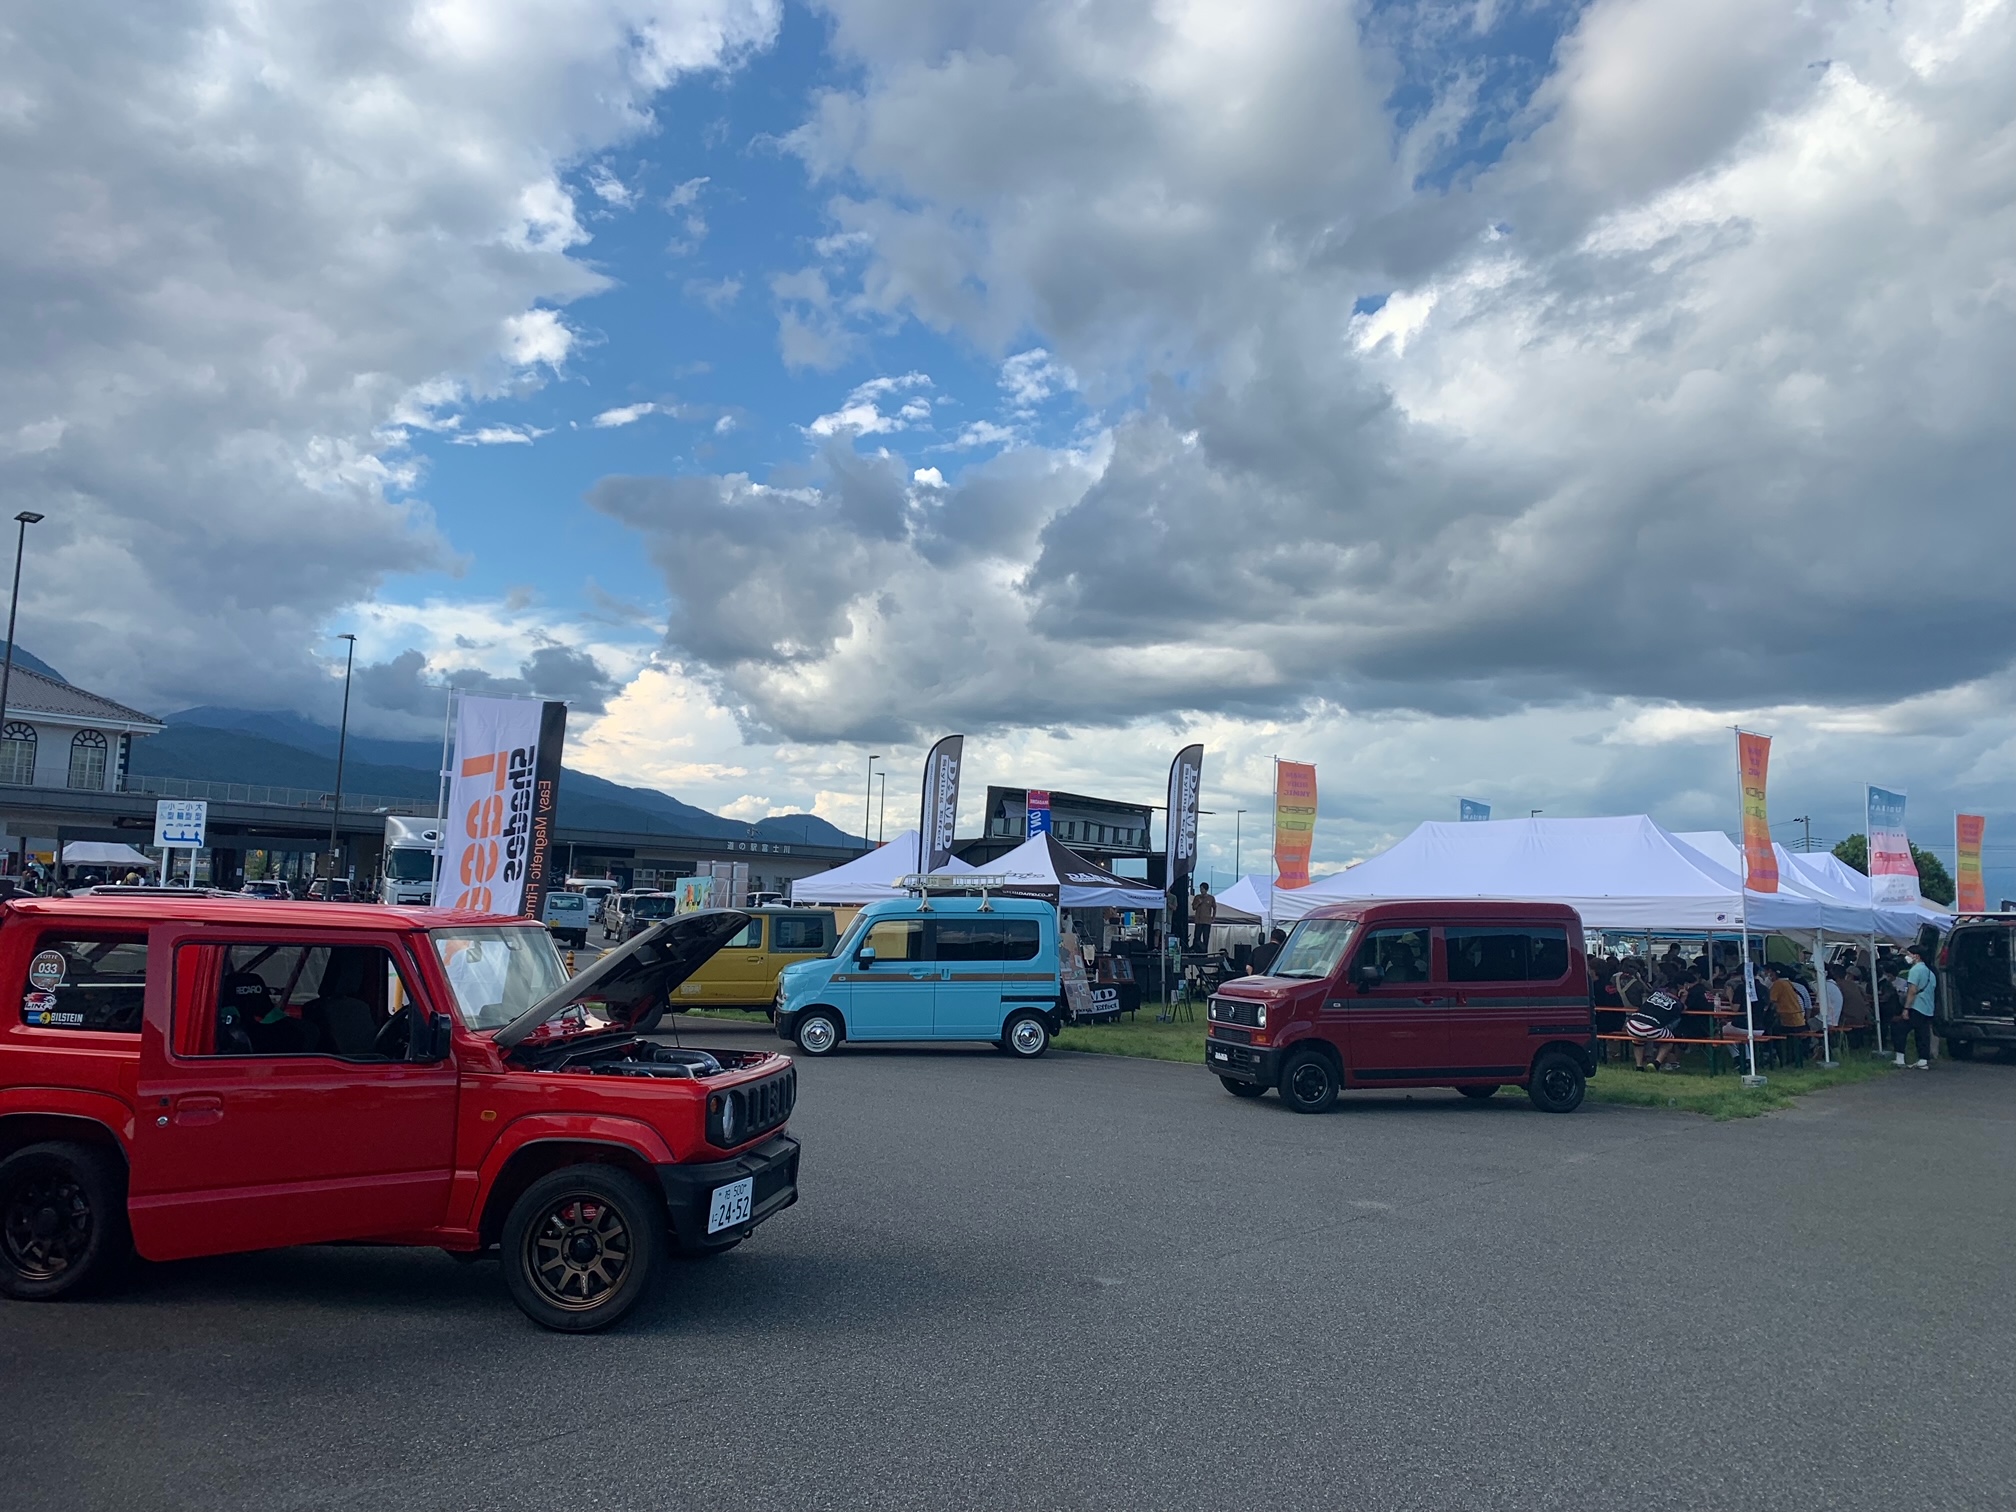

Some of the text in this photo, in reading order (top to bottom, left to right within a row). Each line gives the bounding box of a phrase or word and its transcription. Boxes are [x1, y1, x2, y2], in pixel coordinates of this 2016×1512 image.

[936, 758, 948, 846] Styling Effect
[943, 759, 958, 849] DAMD
[1185, 767, 1199, 857] DAMD
[727, 841, 791, 854] 道の駅富士川
[38, 963, 58, 974] 033
[236, 985, 262, 994] RECARO
[1096, 1002, 1117, 1012] Effect
[51, 1012, 83, 1022] BILSTEIN
[718, 1195, 750, 1227] 24-52
